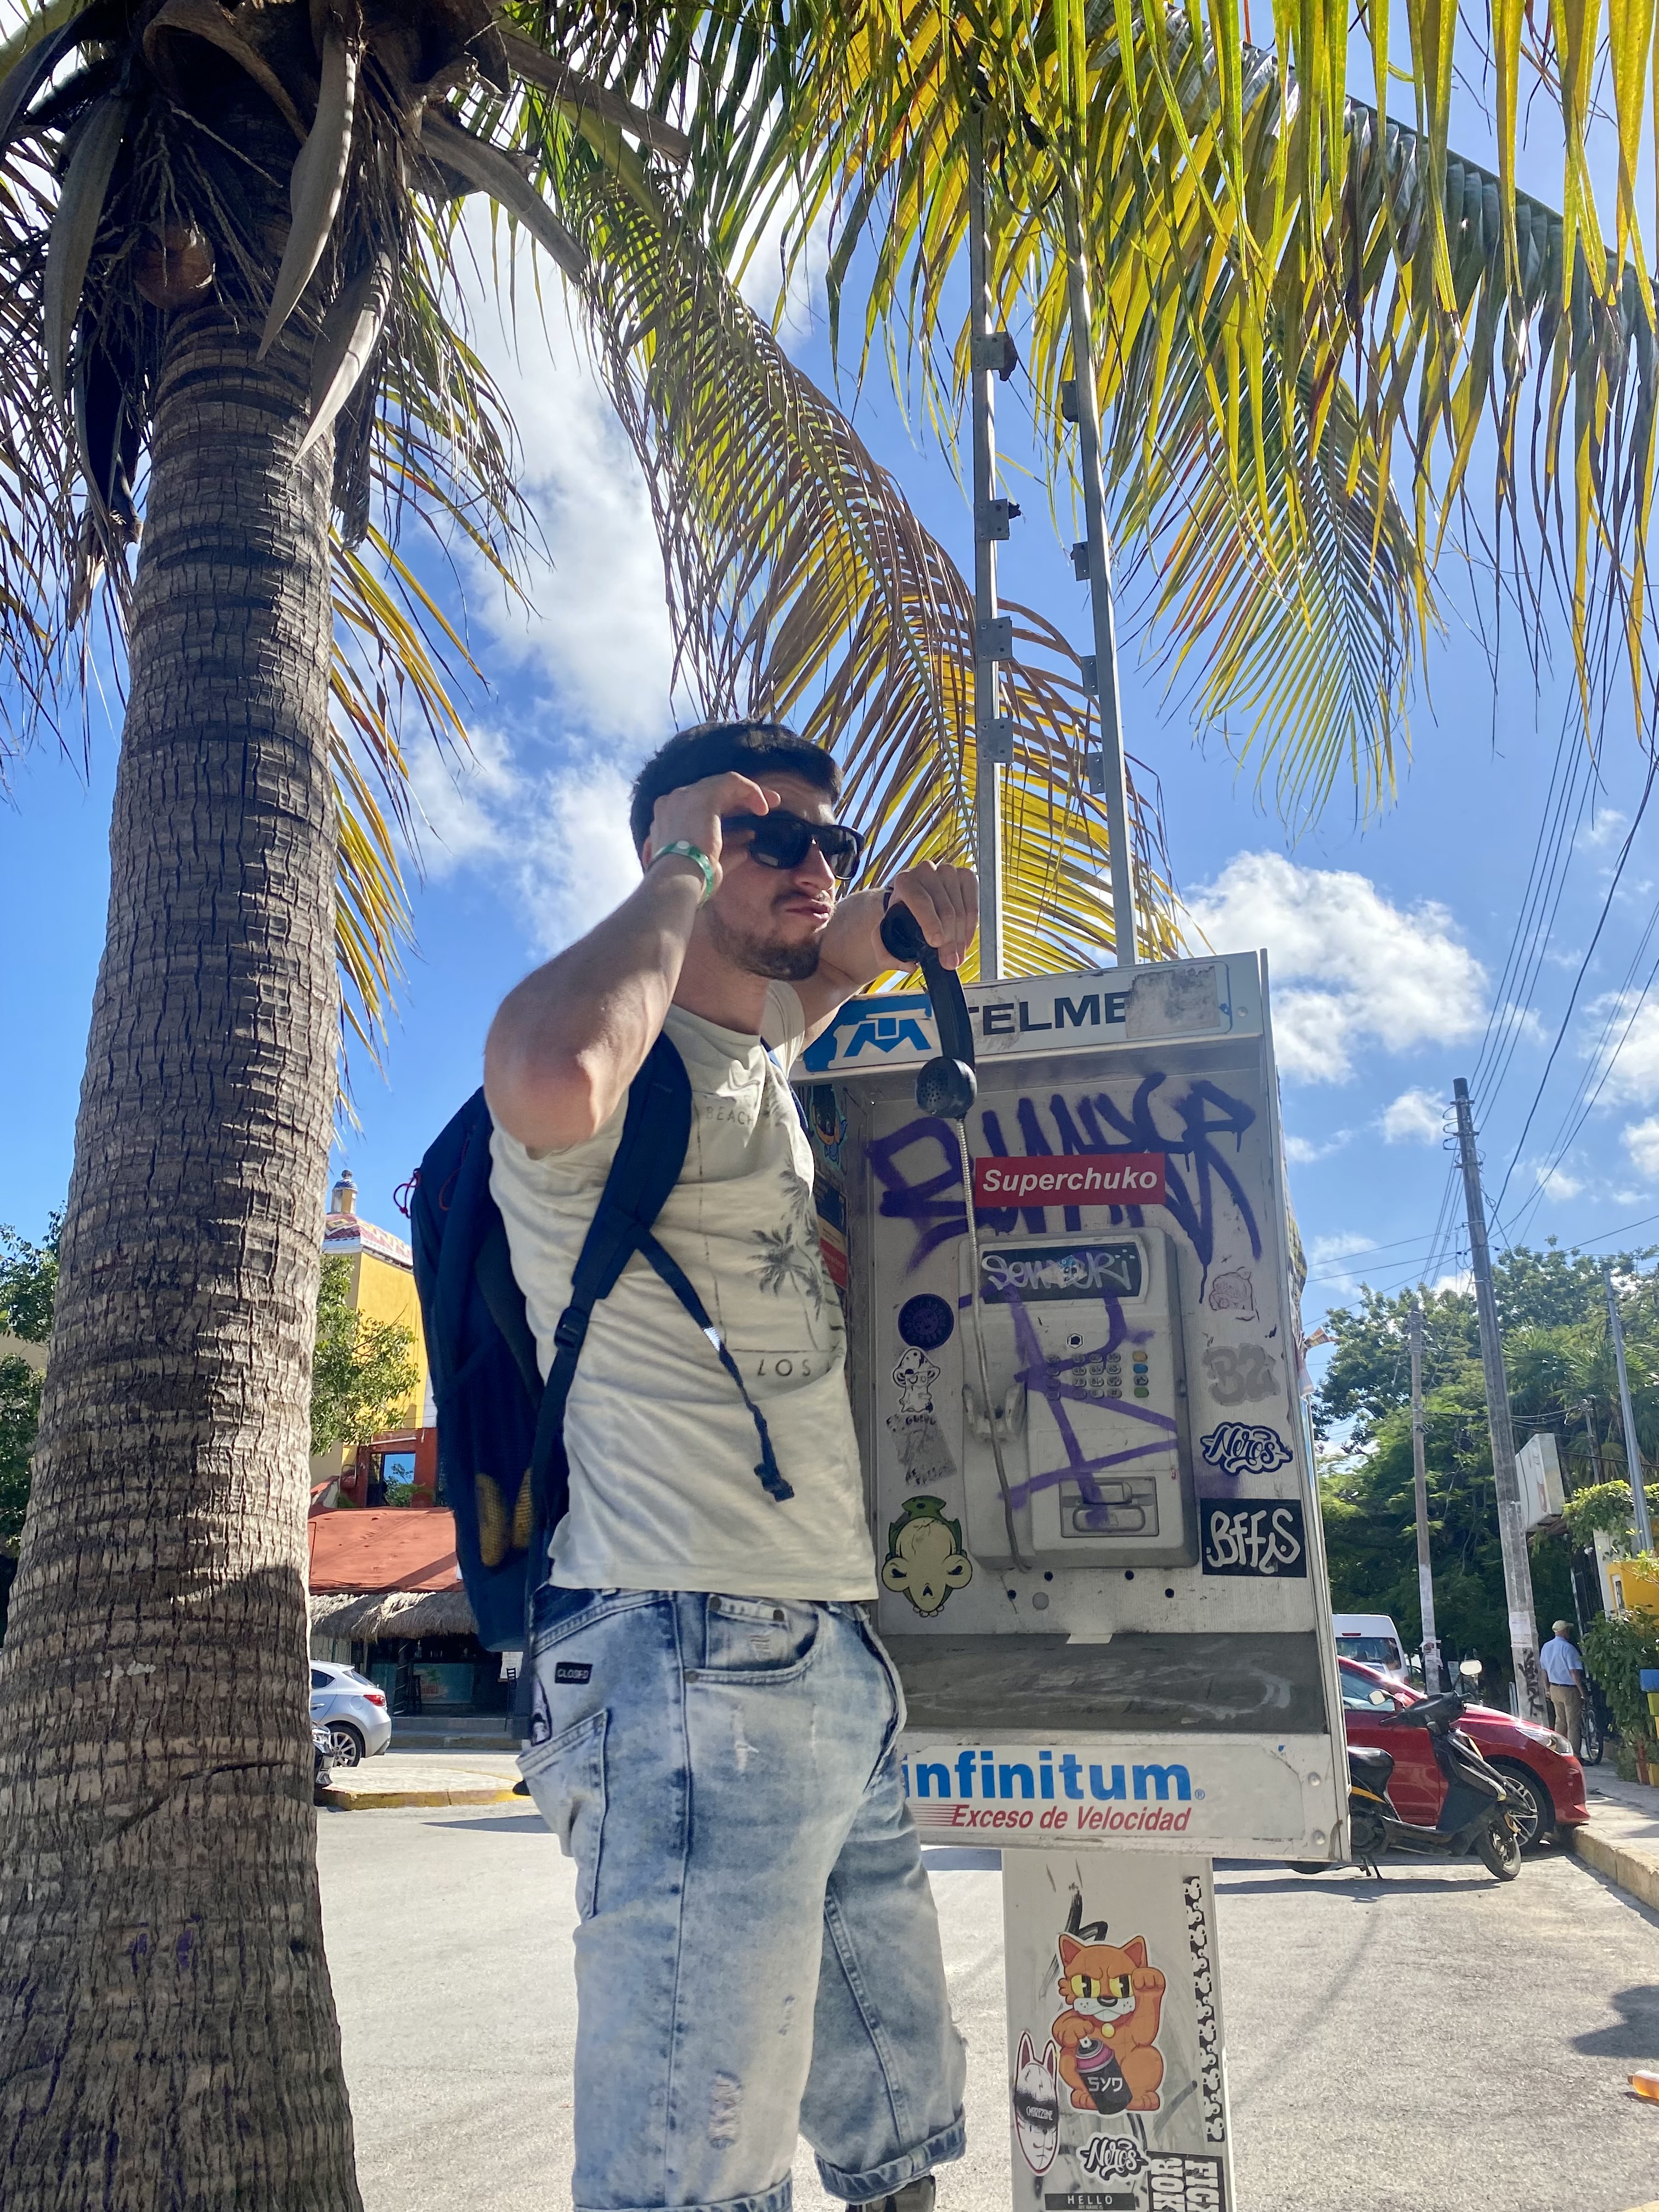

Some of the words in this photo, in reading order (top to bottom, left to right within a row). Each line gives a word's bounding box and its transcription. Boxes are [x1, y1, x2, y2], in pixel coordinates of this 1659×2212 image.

[983, 1166, 1158, 1196] Superchuko
[757, 1358, 811, 1376] LOS
[1209, 1425, 1277, 1471] Neros
[950, 1804, 1034, 1828] Exceso
[1040, 1805, 1068, 1829] de
[1077, 1805, 1192, 1831] Velocidad
[1086, 2137, 1137, 2177] Neros
[1067, 2195, 1113, 2204] HELLO
